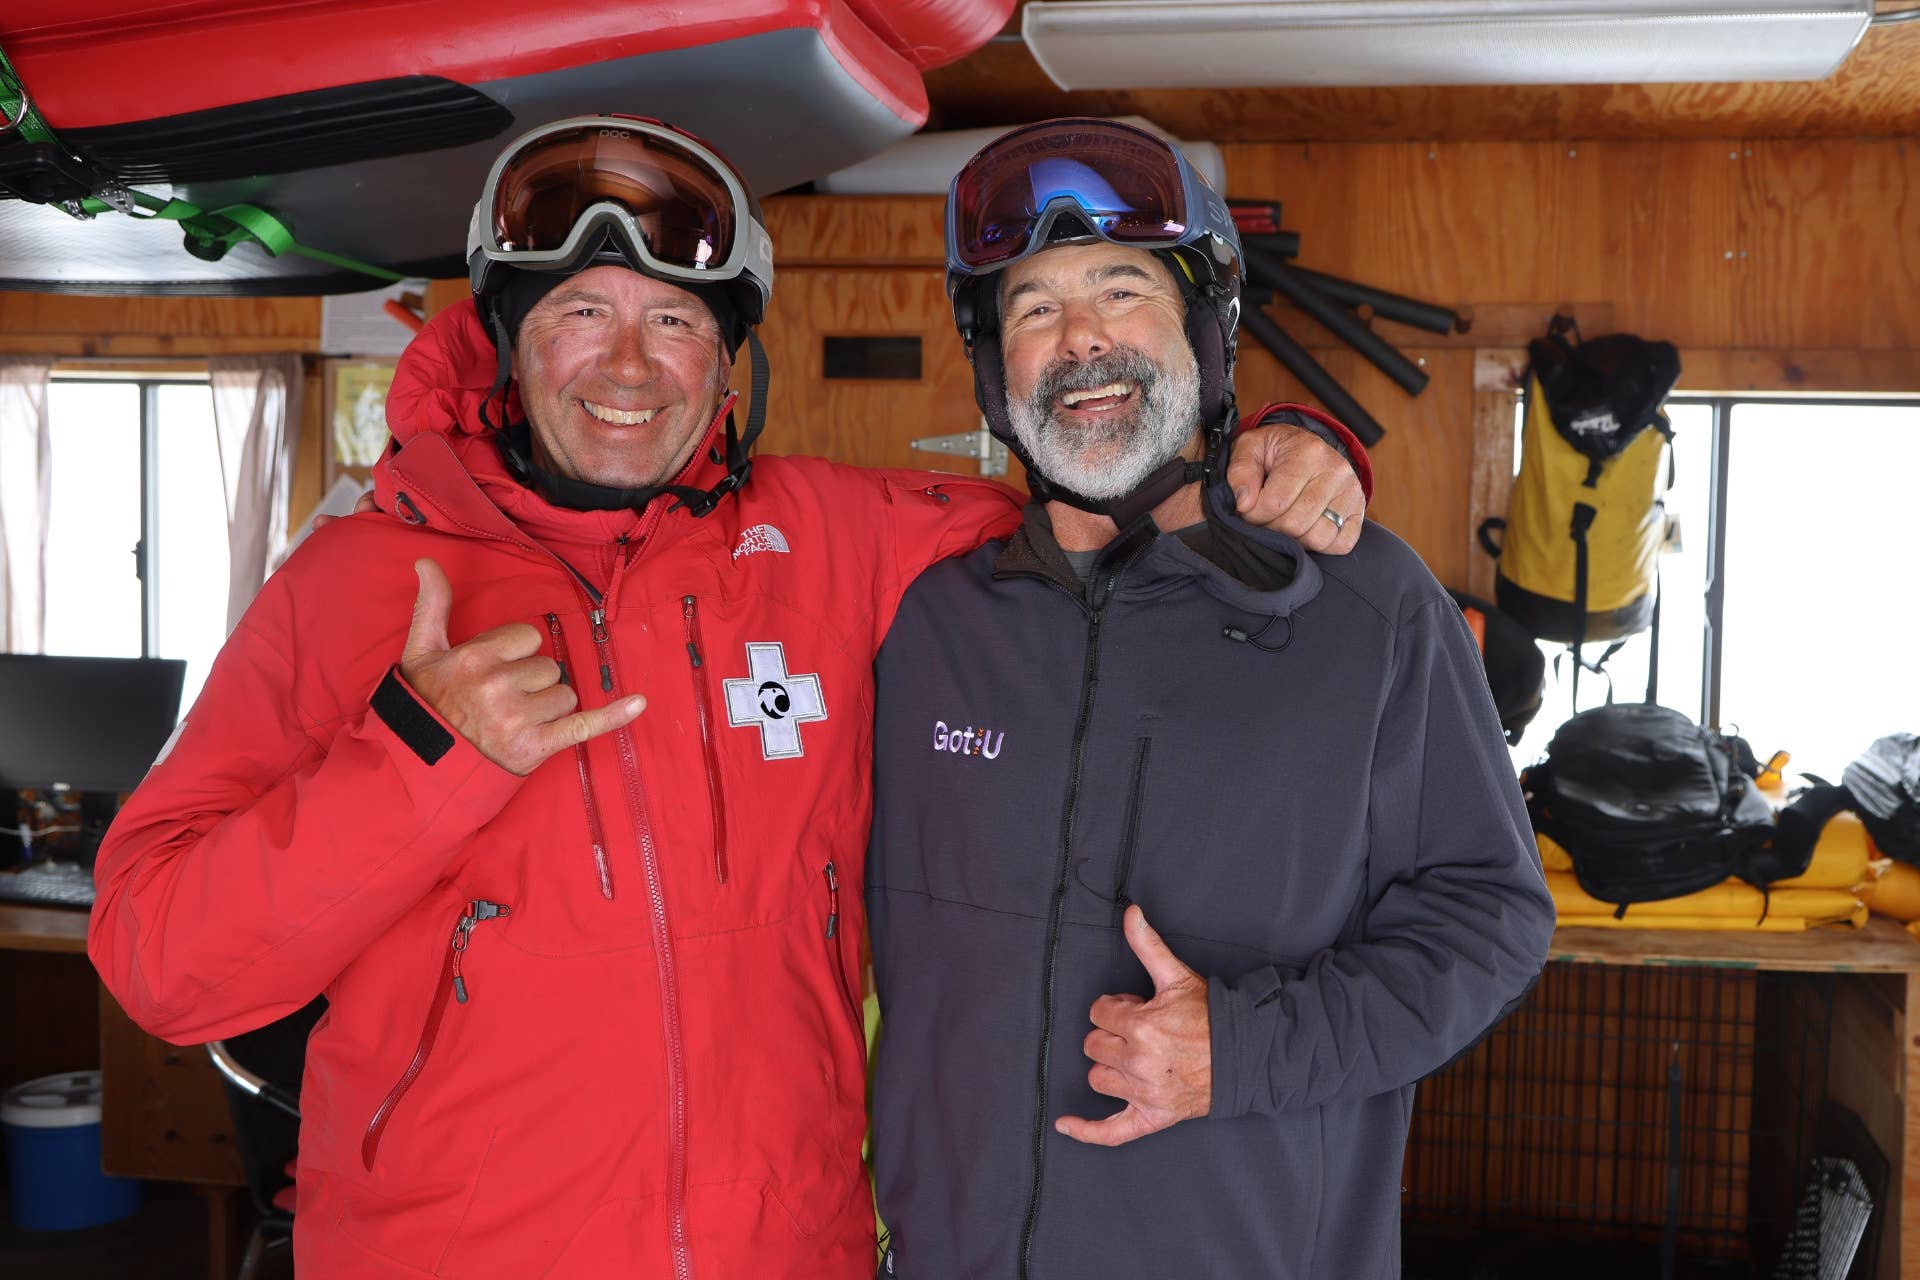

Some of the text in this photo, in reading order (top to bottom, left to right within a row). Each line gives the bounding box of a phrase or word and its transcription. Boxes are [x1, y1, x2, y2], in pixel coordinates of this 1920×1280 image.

[741, 525, 767, 539] THE
[733, 533, 770, 560] NORTH
[745, 542, 775, 556] FACE
